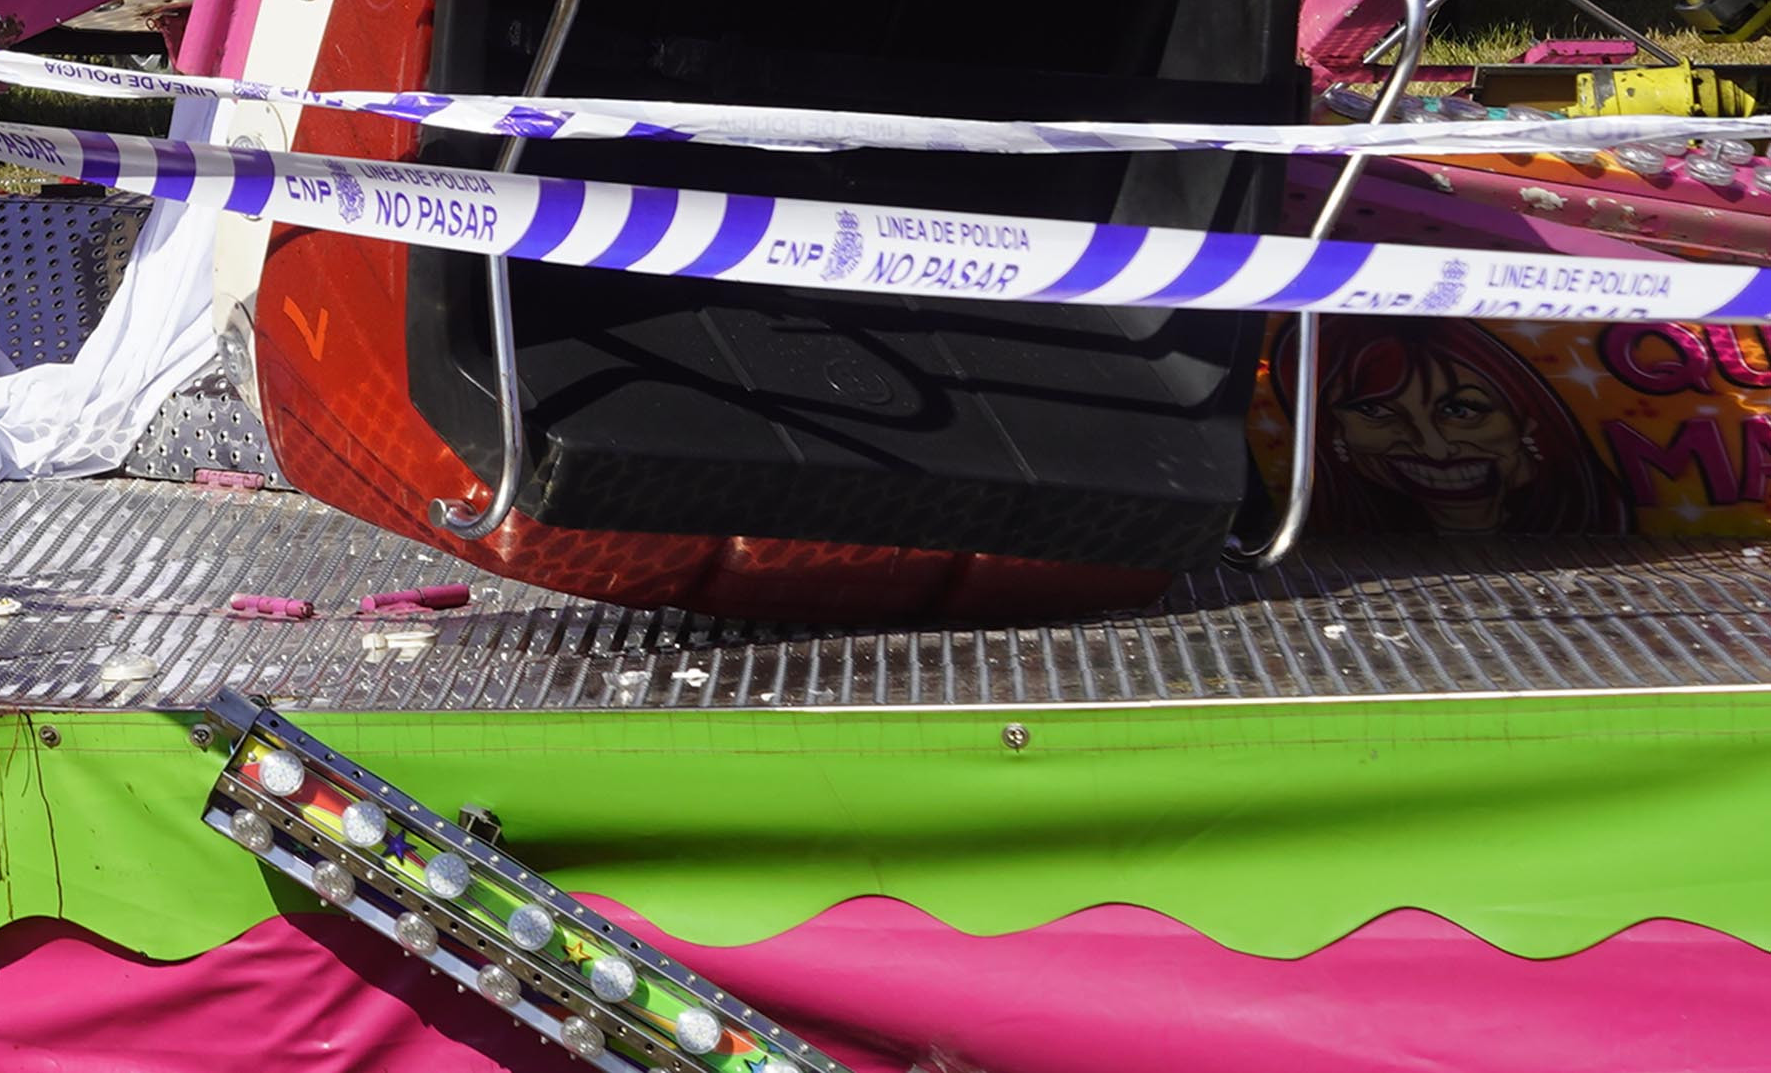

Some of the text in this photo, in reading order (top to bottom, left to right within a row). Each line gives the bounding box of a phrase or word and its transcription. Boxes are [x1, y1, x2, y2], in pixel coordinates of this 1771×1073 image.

[44, 60, 219, 98] LINEA DE POLICIA
[284, 175, 332, 204] CNP
[356, 162, 496, 196] LINEA DE POLICIA
[375, 189, 499, 242] NO PASAR
[876, 214, 1031, 252] LINEA DE POLICIA
[766, 239, 825, 268] CNP
[865, 250, 1019, 294] NO PASAR
[1488, 263, 1673, 299] LINEA DE POLICIA
